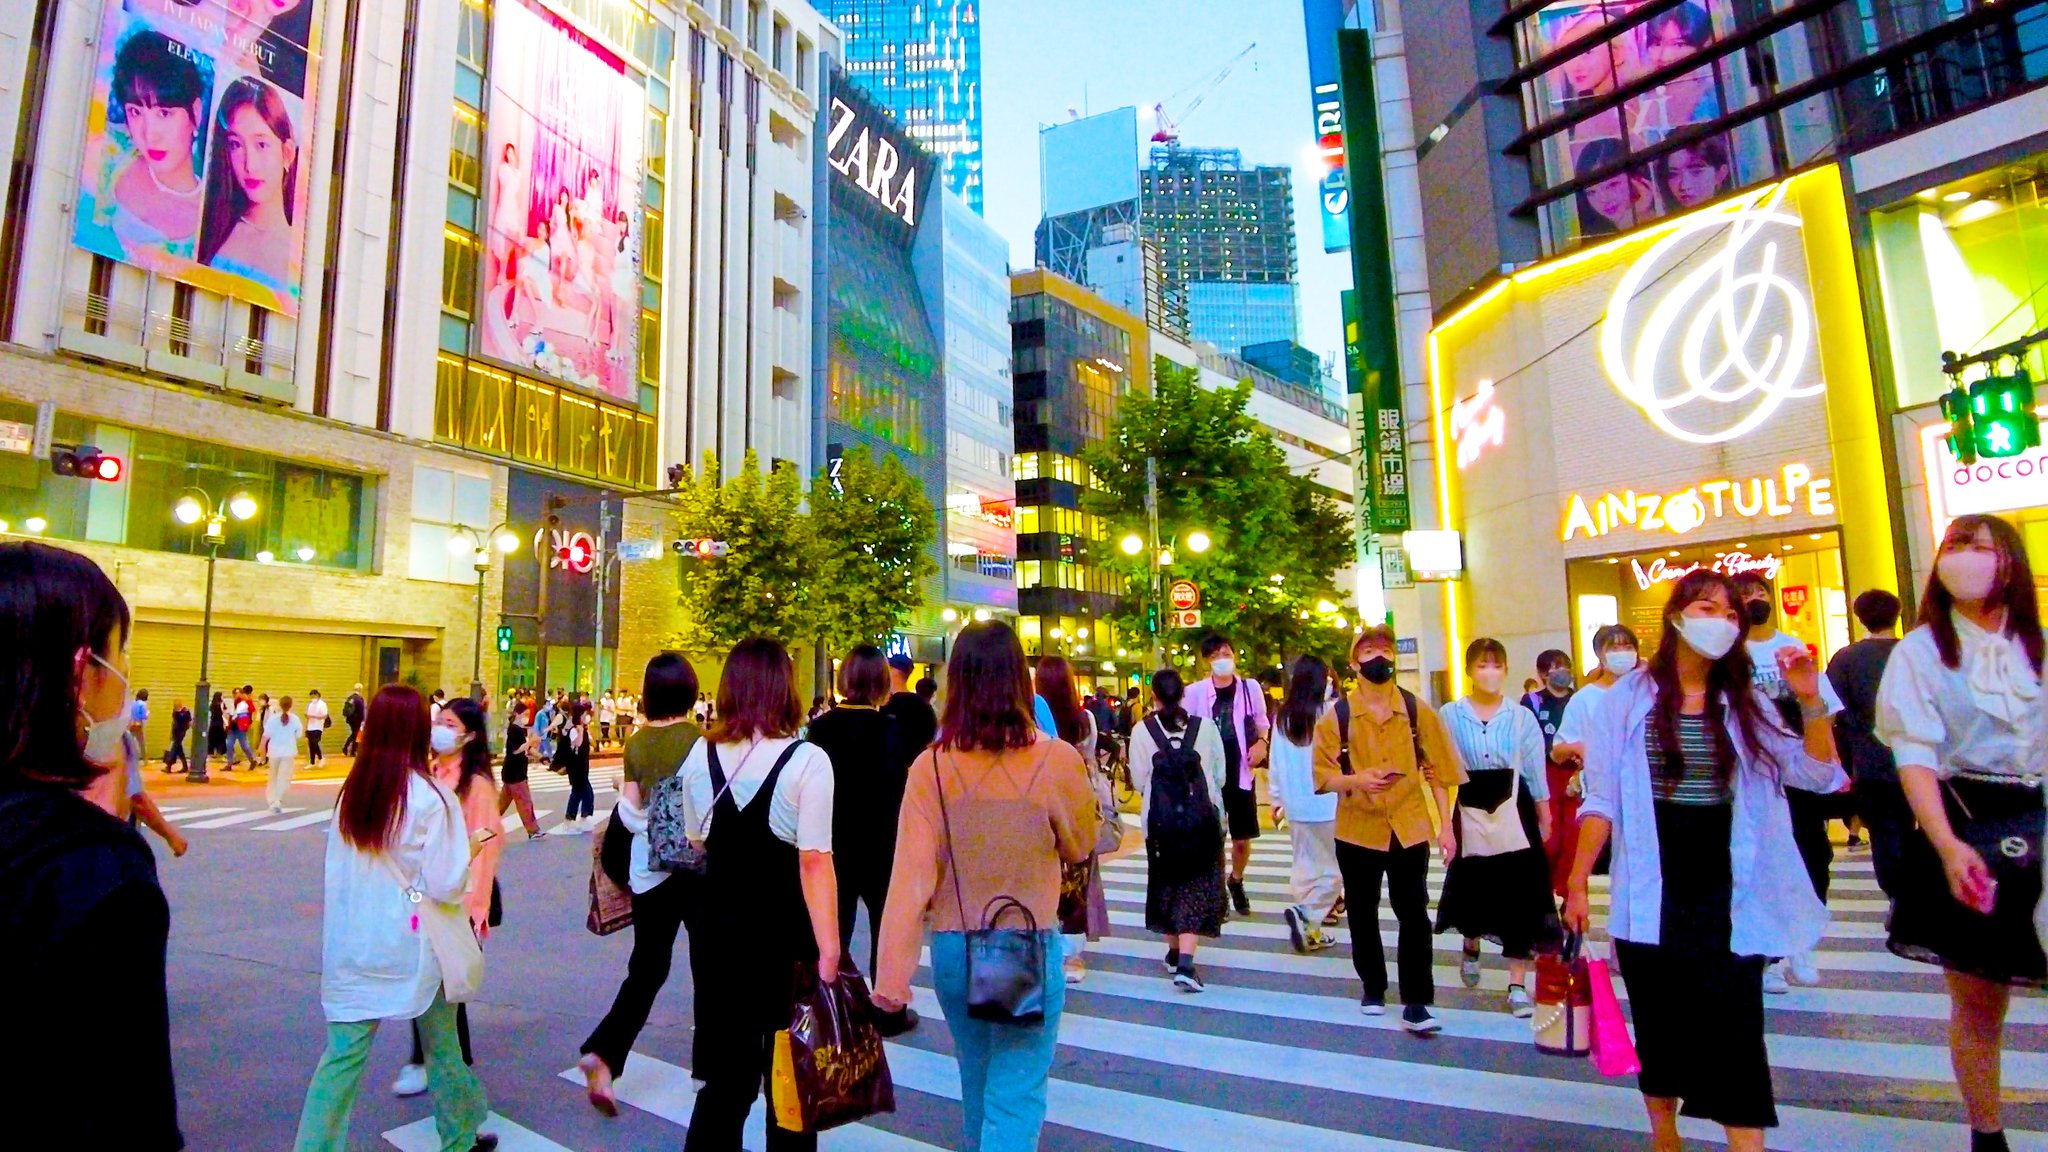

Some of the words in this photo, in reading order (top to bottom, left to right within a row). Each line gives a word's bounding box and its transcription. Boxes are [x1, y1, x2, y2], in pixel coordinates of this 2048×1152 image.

[232, 32, 277, 66] DEBUT
[827, 97, 916, 226] ZARA
[1378, 409, 1405, 495] 眼鏡市場
[1562, 489, 1665, 541] AINZ
[1701, 463, 1835, 518] TULPE
